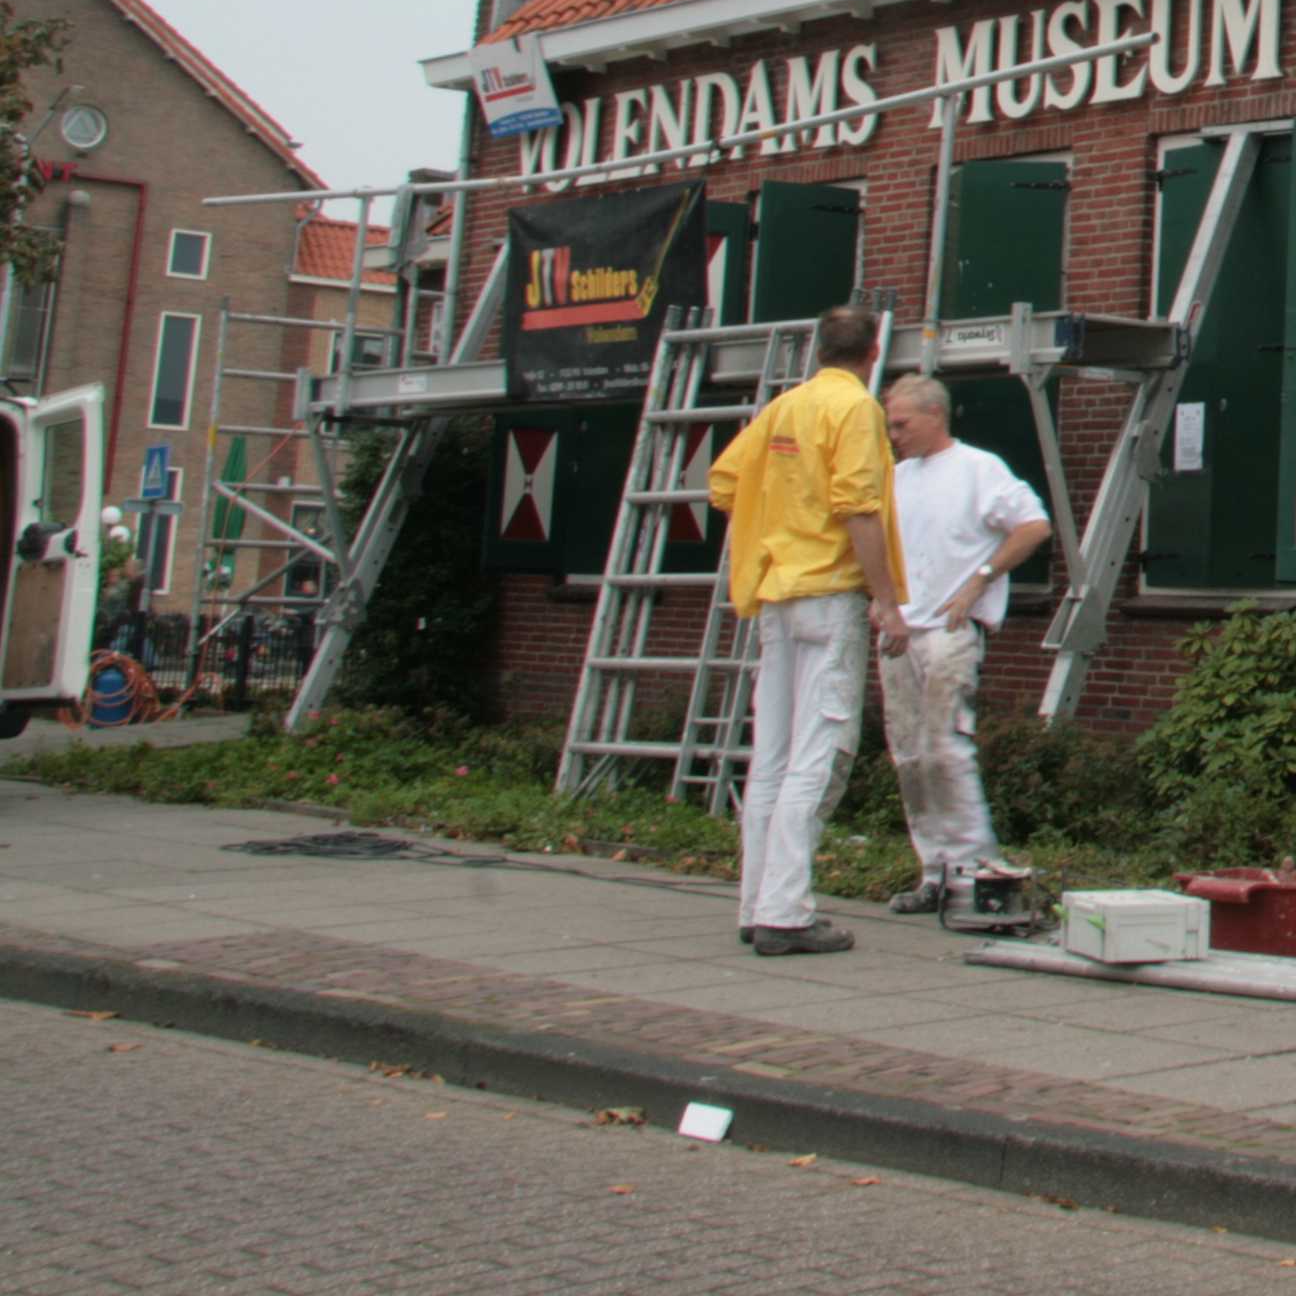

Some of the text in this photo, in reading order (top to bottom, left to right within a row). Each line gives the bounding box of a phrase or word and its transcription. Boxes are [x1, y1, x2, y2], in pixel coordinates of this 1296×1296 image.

[518, 42, 879, 193] VOLENDAMS
[526, 246, 638, 308] JTV Schilders
